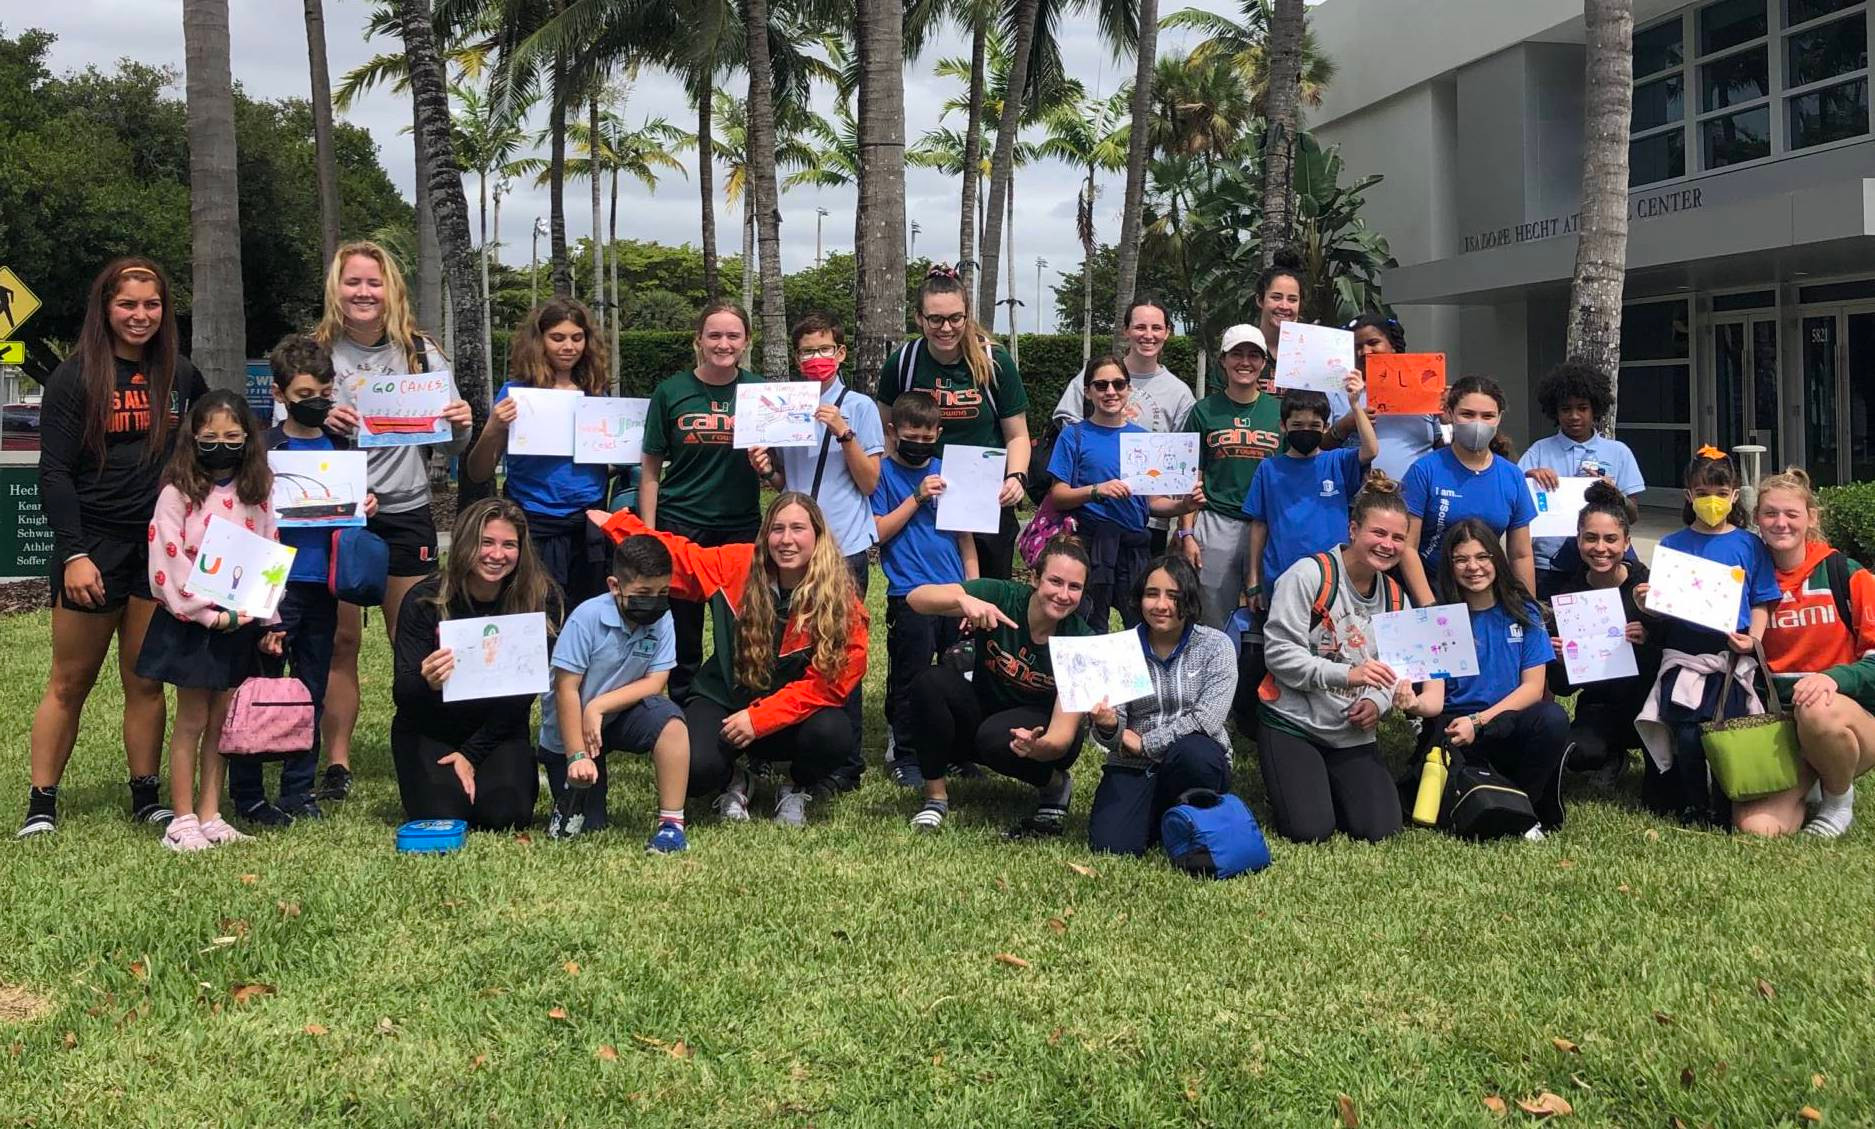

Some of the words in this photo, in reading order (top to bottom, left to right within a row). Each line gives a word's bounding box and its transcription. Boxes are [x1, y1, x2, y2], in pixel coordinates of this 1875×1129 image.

[1516, 218, 1559, 242] HECHT
[1637, 187, 1703, 219] CENTER
[1811, 327, 1828, 343] 5821
[373, 382, 395, 394] GO
[401, 379, 443, 394] CANES
[17, 529, 54, 538] Schwar
[23, 541, 54, 551] Athlet
[16, 556, 47, 566] Soffer
